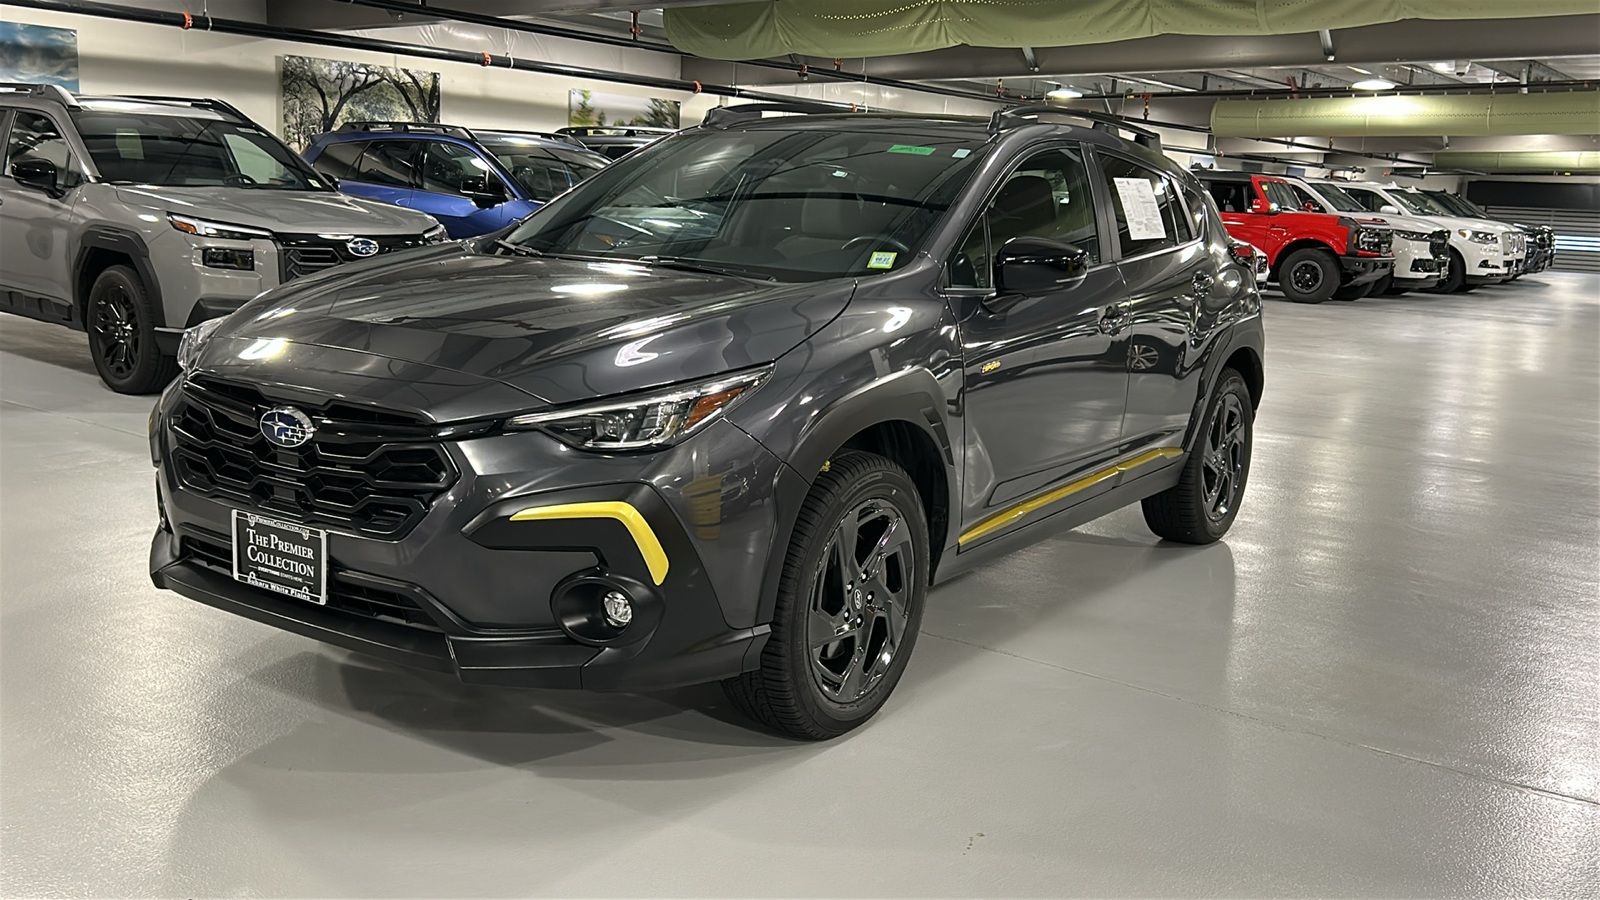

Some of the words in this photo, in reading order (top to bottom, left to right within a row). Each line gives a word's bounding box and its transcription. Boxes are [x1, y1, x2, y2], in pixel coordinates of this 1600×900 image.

[246, 528, 269, 548] THE
[270, 533, 315, 560] PREMIER
[247, 545, 315, 578] COLLECTION
[247, 577, 269, 589] Subaru
[270, 584, 289, 595] White
[290, 589, 311, 600] Plains
